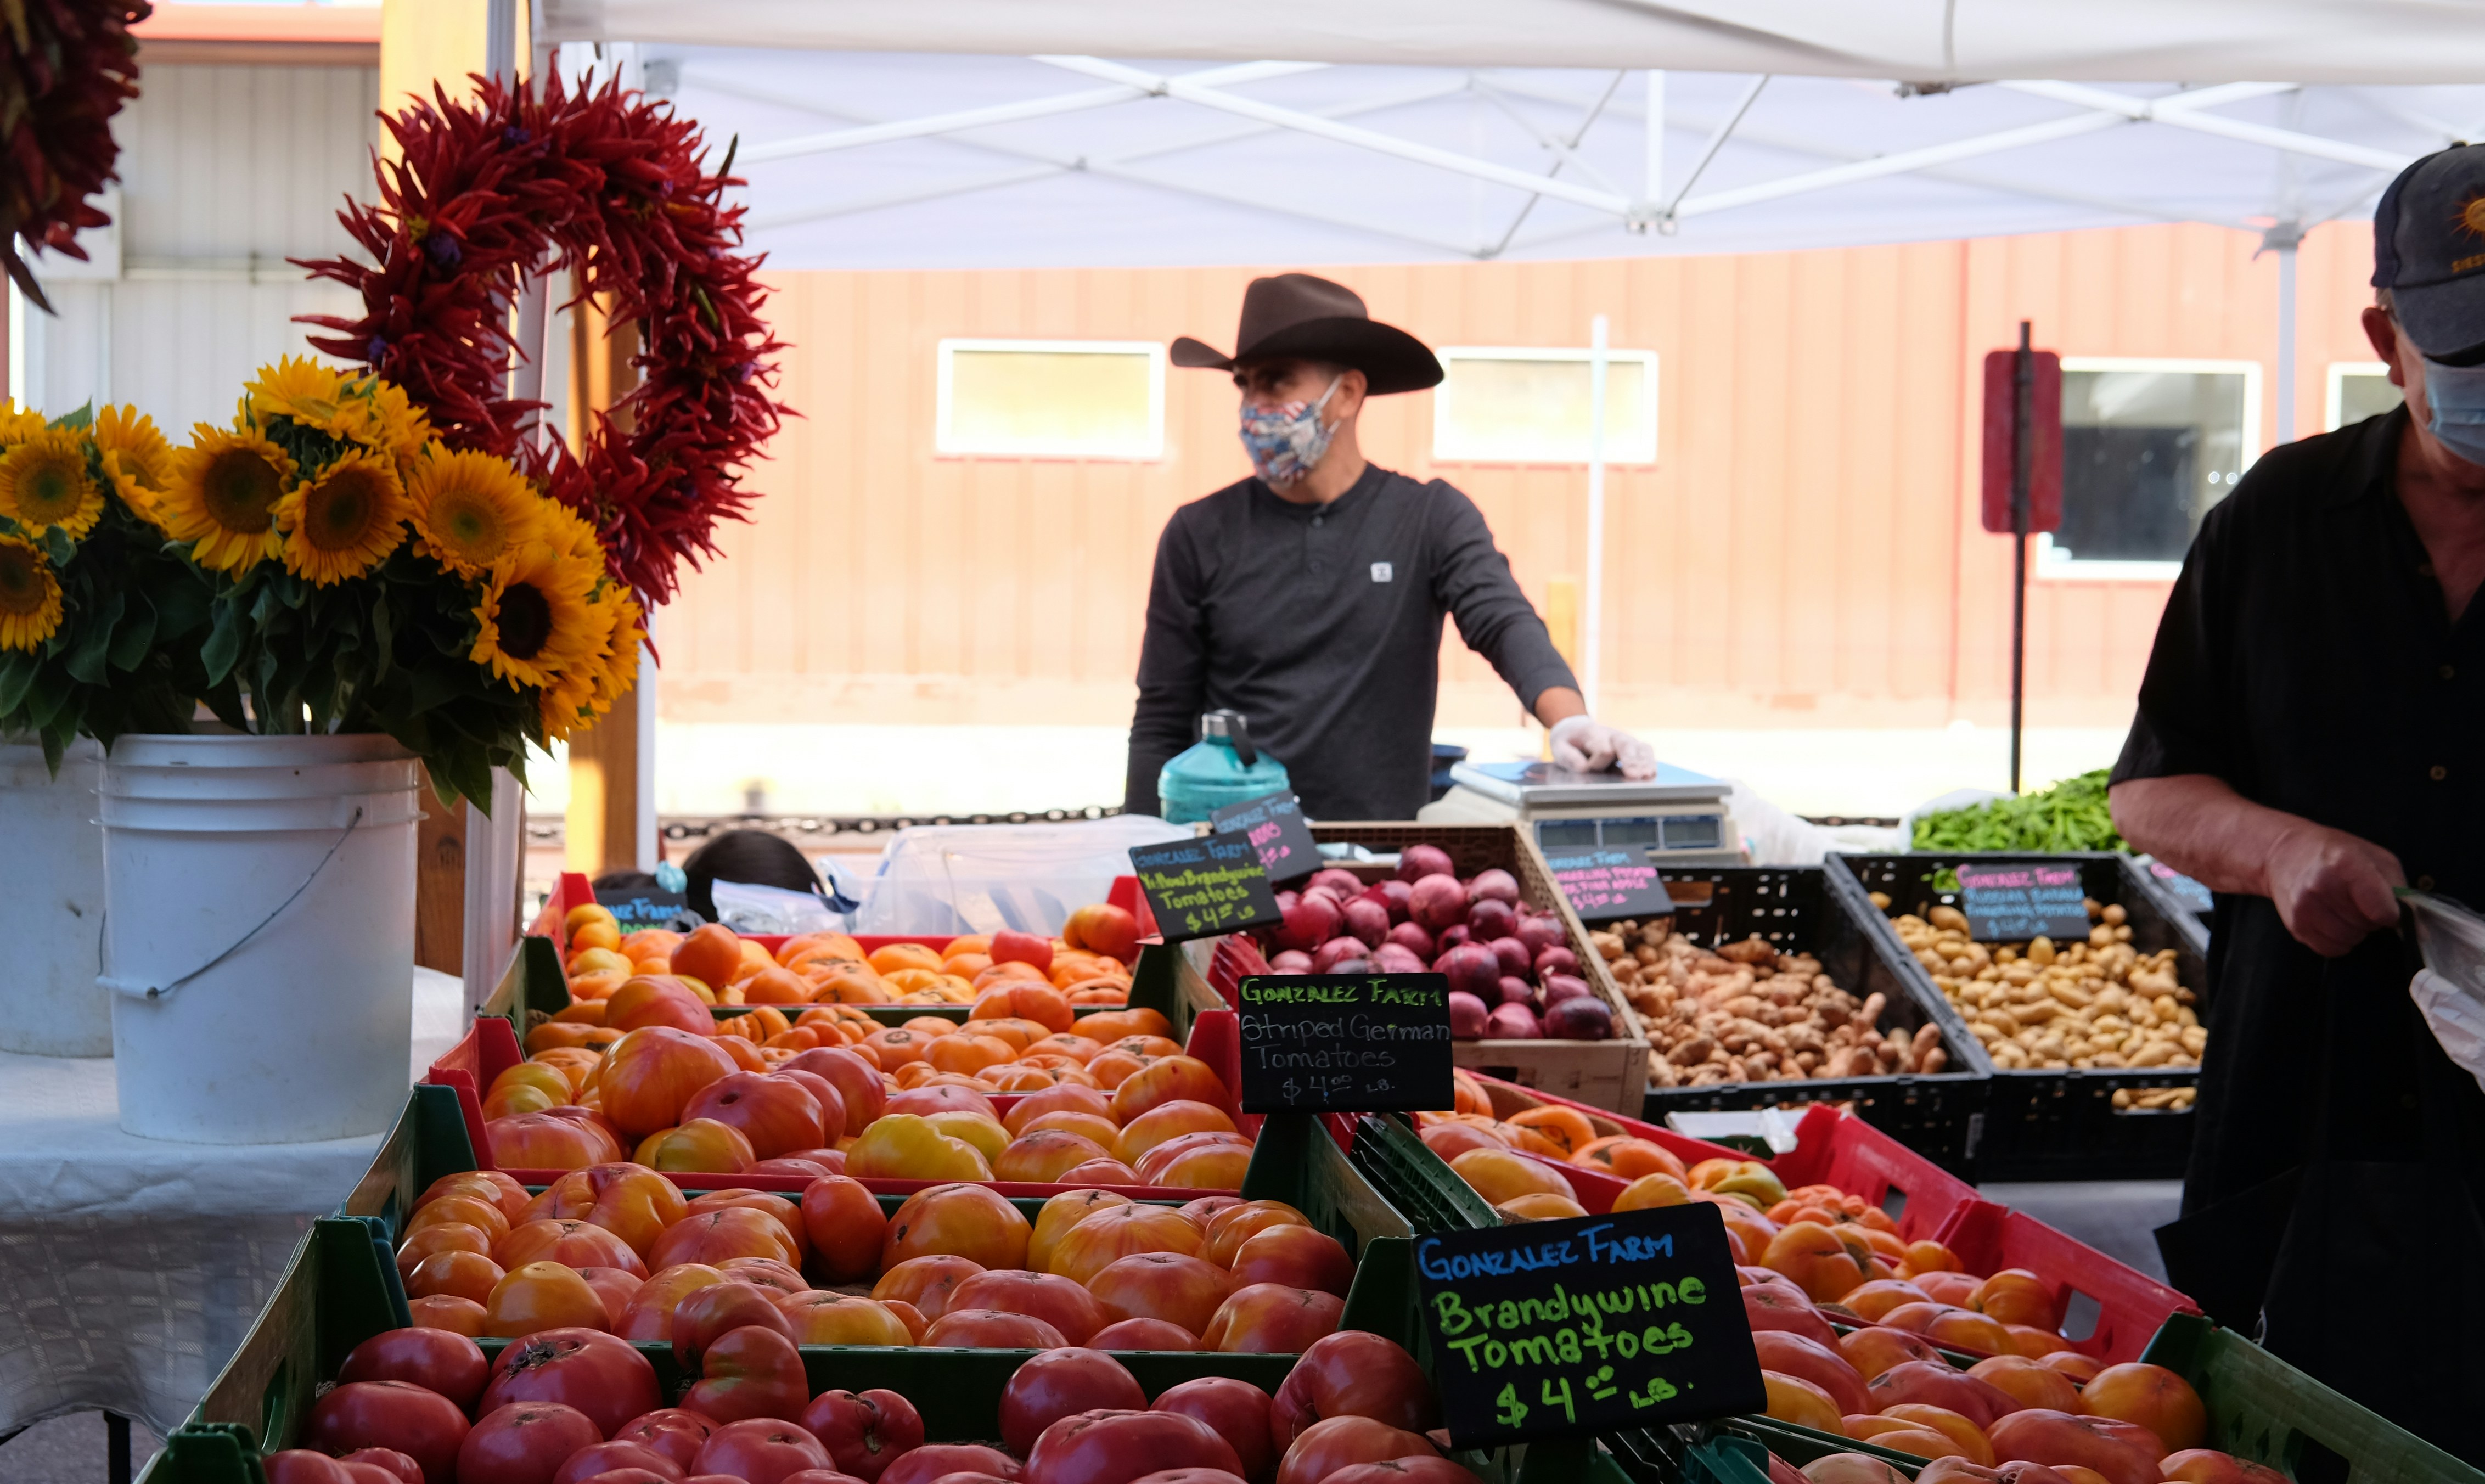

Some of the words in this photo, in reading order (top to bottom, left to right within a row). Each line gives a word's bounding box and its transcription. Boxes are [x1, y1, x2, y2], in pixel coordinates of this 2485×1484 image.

[1129, 847, 1206, 868] GONZALEZ
[1201, 839, 1250, 860] FARM
[1159, 885, 1250, 909] Tomatoes
[1241, 977, 1359, 1005] GONZALEZ
[1367, 978, 1442, 1007] FARM
[1241, 1014, 1345, 1046] Striped
[1350, 1014, 1450, 1041] German
[1250, 1043, 1396, 1069] Tomatoes
[1418, 1238, 1579, 1281] GONZALEZ
[1577, 1223, 1673, 1263] FARM
[1431, 1276, 1706, 1337] Brandywine
[1447, 1322, 1693, 1373] Tomatoes
